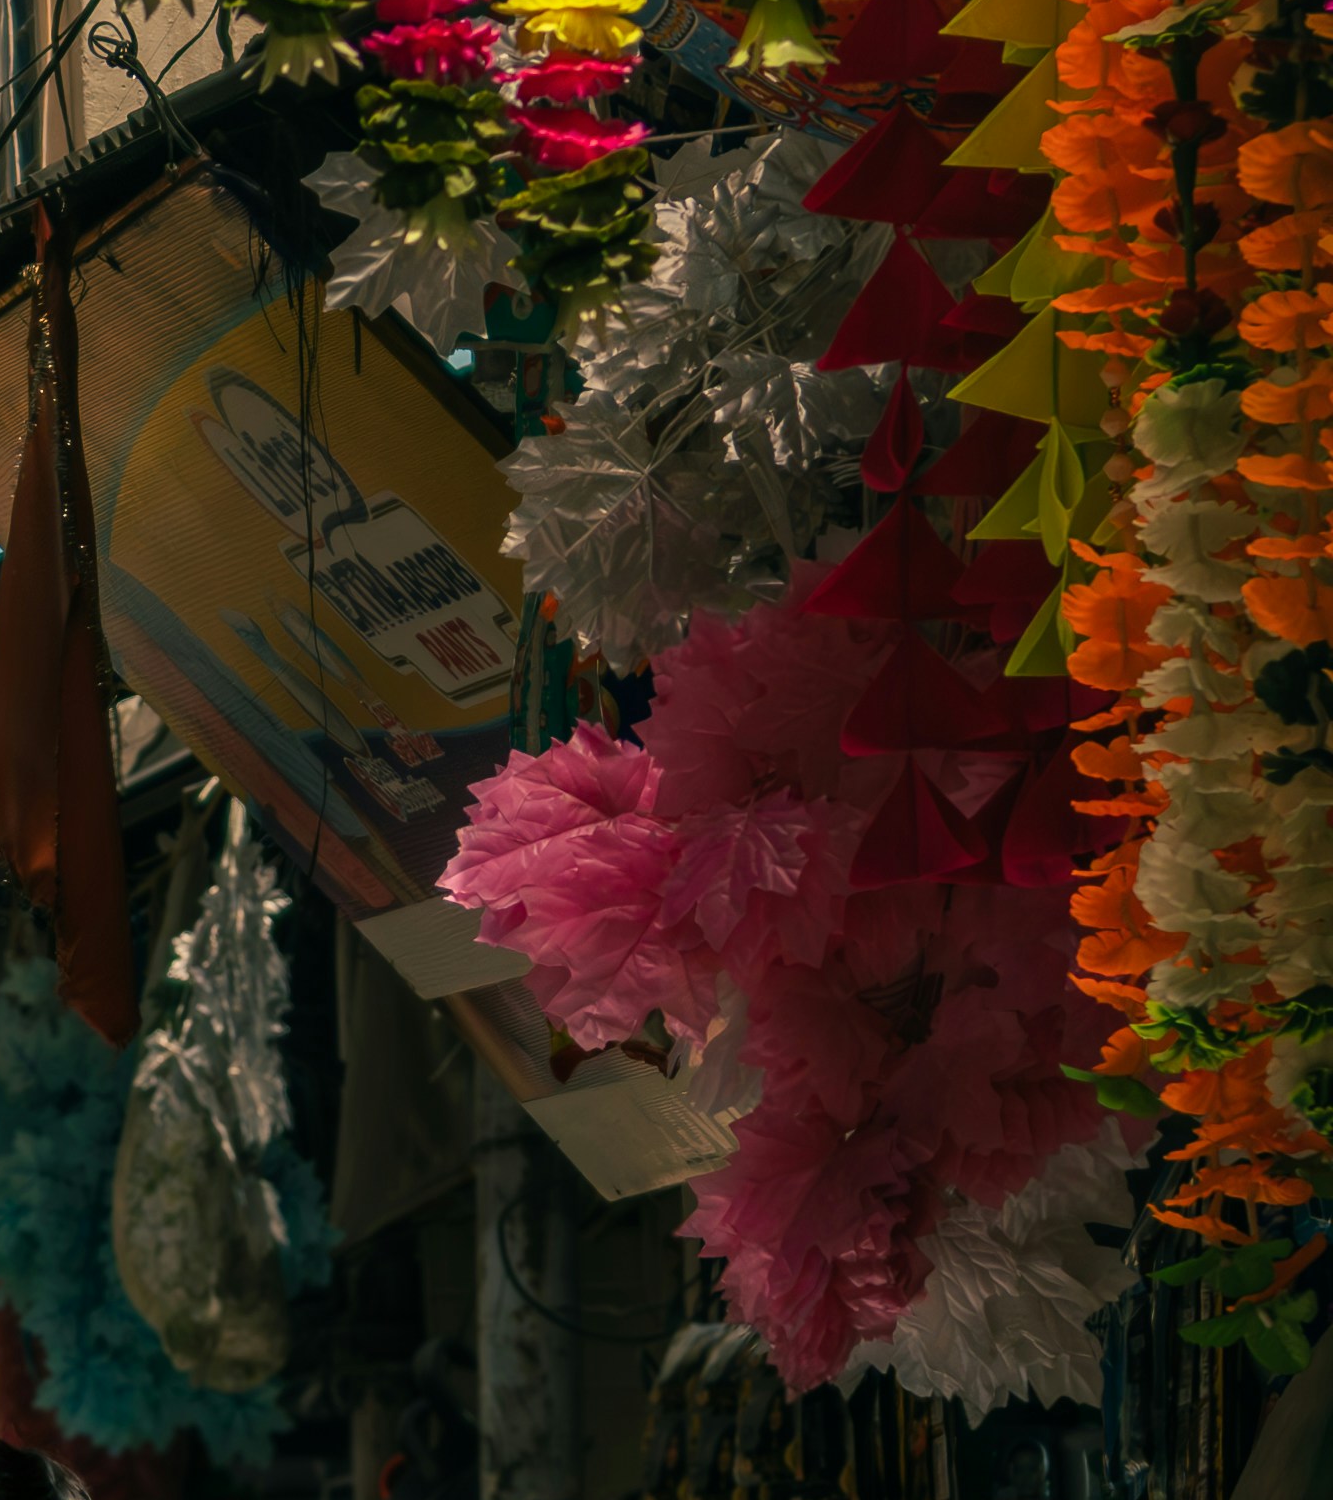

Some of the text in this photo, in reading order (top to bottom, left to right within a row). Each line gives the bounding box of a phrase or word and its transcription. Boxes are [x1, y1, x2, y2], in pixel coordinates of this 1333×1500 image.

[311, 540, 483, 638] EXTRA ABSORB
[414, 611, 505, 681] PANTS
